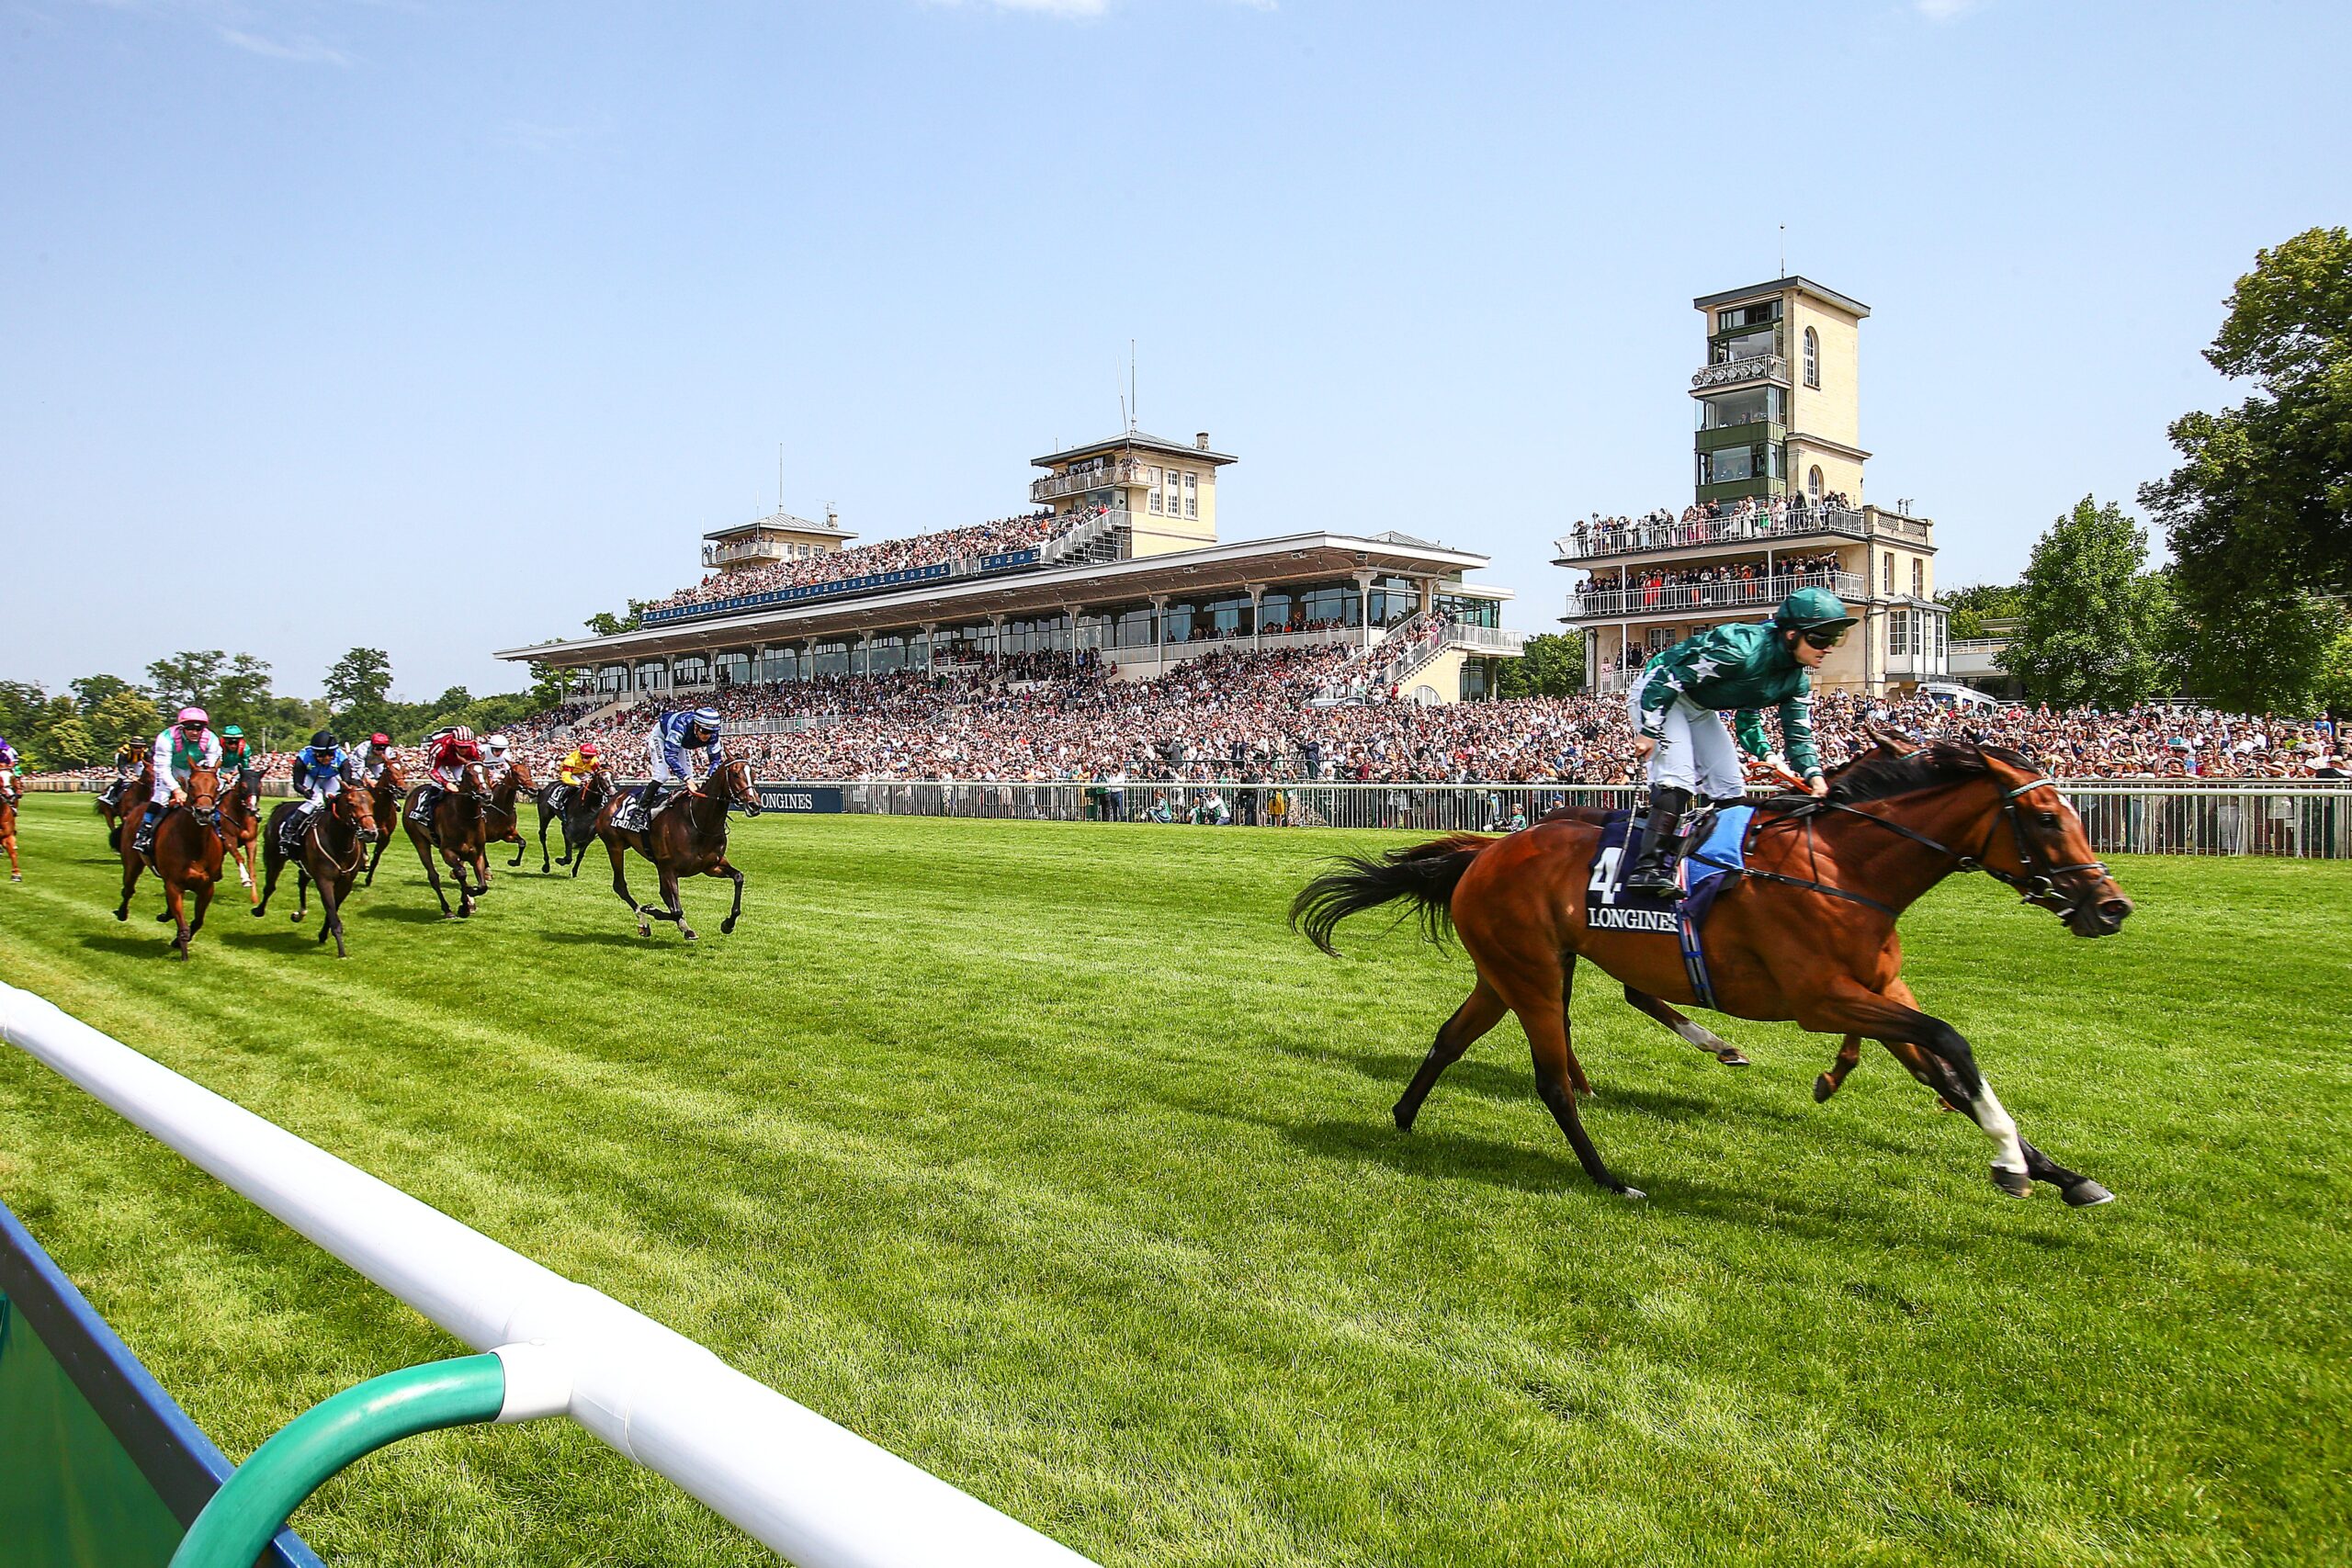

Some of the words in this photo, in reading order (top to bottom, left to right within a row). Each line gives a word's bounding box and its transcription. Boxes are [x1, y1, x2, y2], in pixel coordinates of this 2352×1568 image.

[761, 793, 813, 809] ONGINES
[1589, 847, 1623, 904] 4
[1588, 908, 1679, 932] LONGINES
